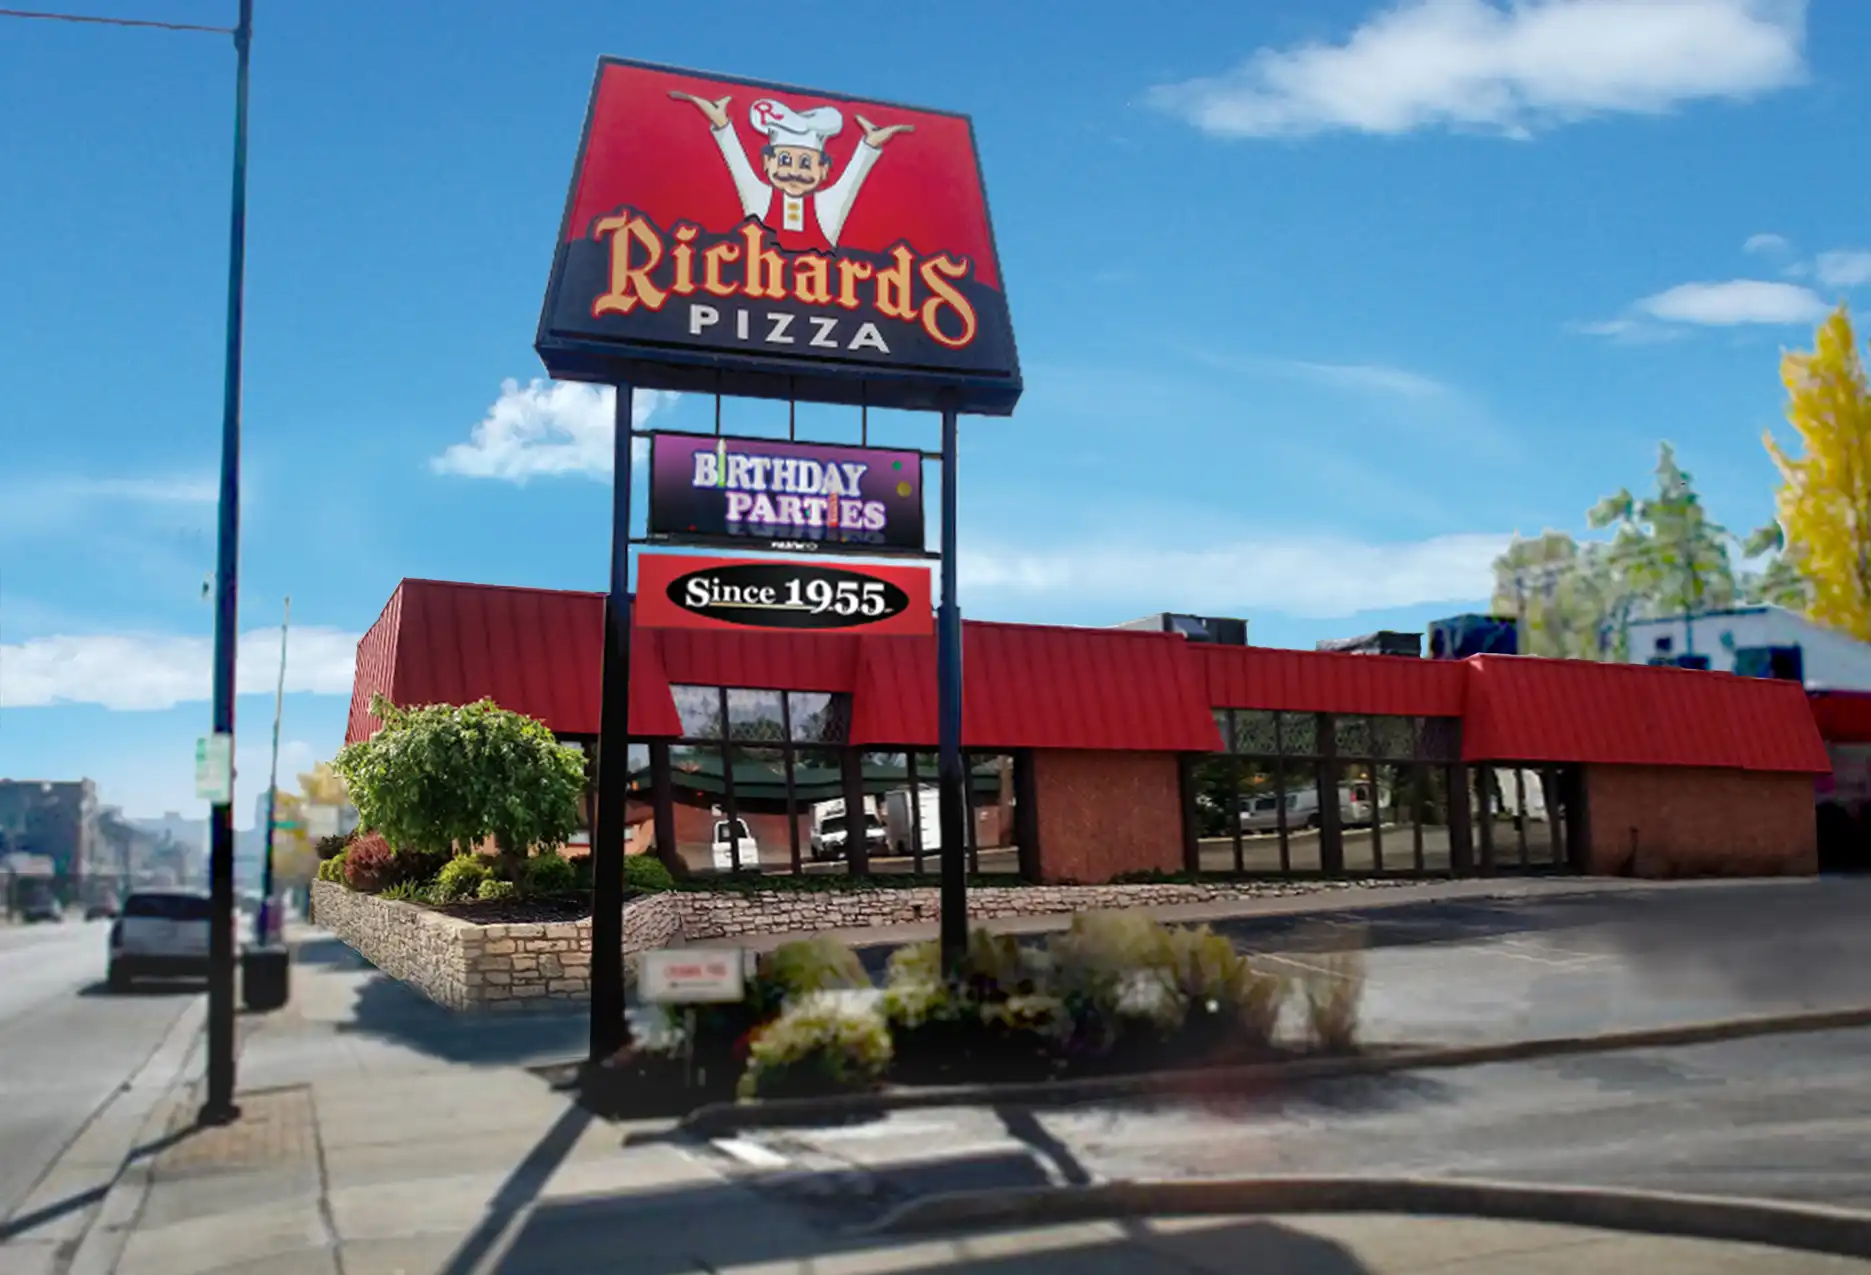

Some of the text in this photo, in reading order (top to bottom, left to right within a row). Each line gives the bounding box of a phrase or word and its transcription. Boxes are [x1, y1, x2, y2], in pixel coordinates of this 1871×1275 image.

[752, 101, 783, 125] R
[689, 304, 891, 353] PIZZA
[693, 440, 867, 496] BIRTHDAY
[726, 492, 886, 530] PARTIES
[685, 577, 886, 616] Since 1955
